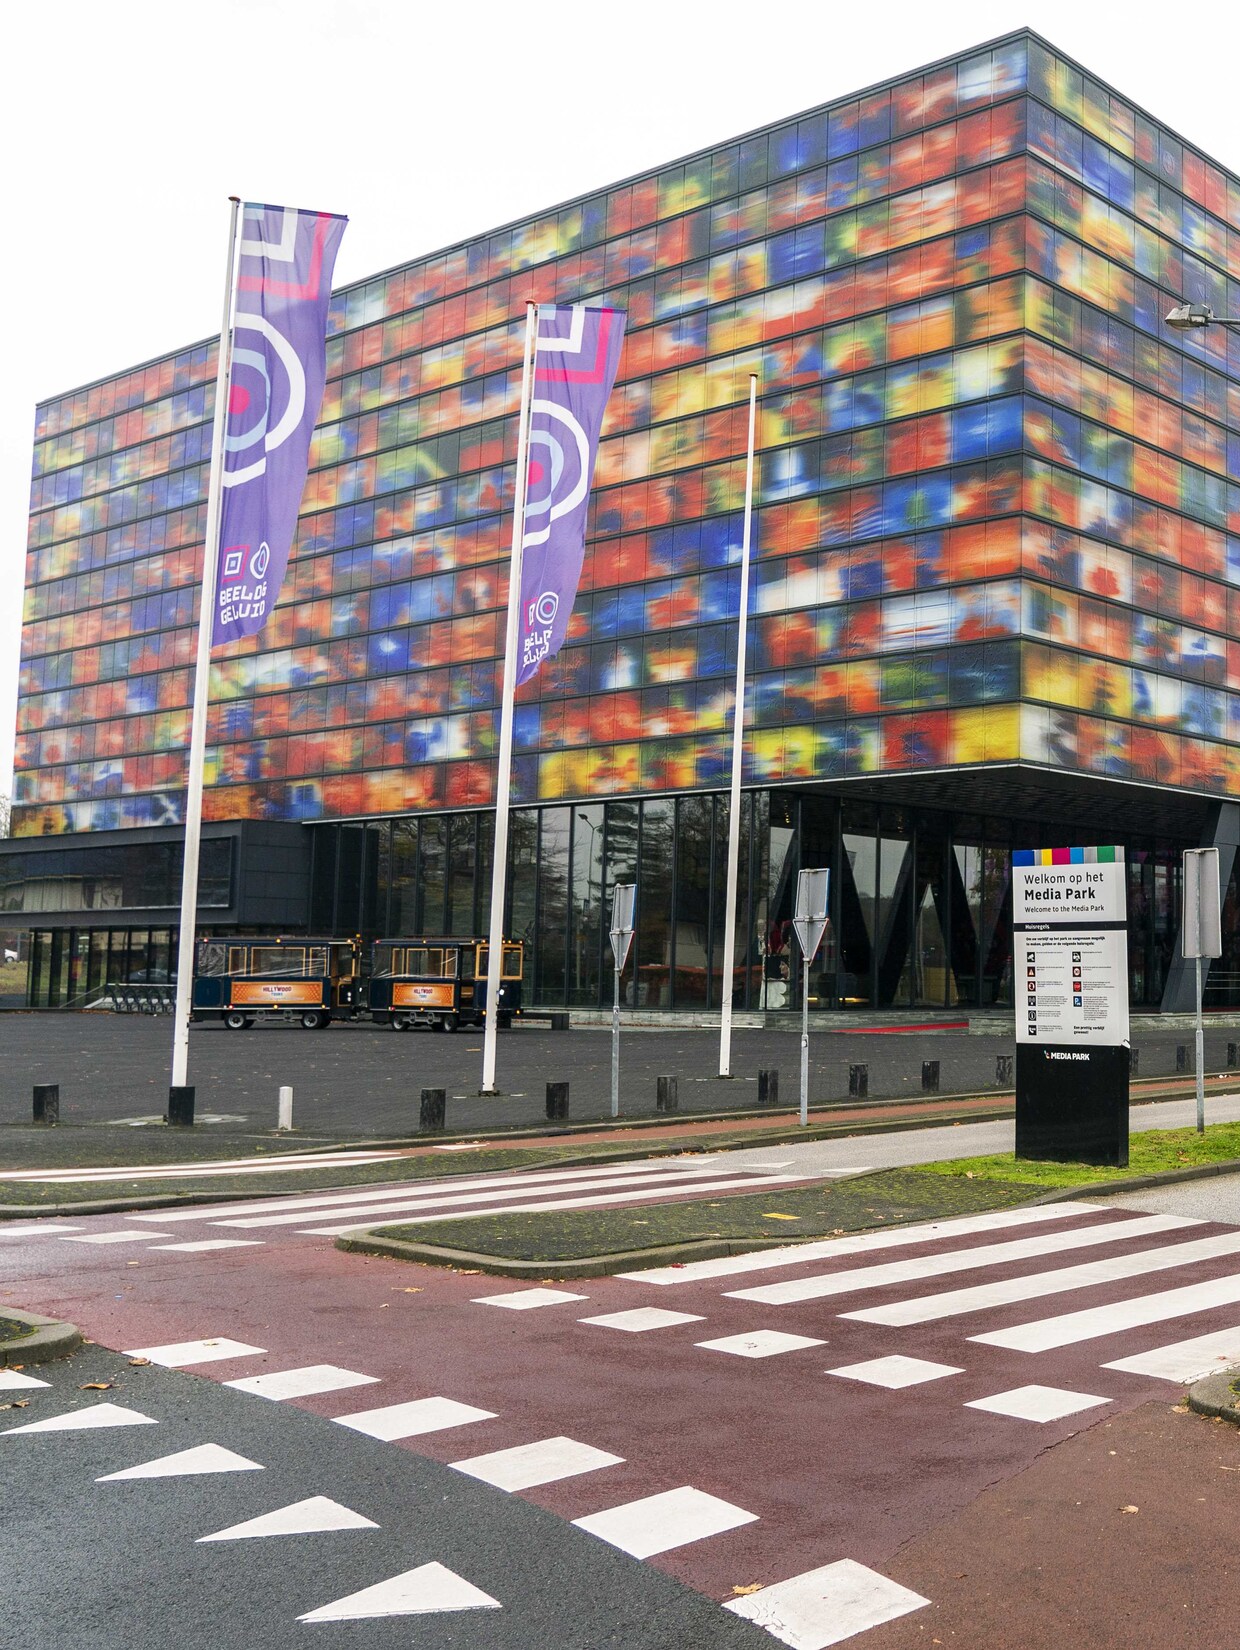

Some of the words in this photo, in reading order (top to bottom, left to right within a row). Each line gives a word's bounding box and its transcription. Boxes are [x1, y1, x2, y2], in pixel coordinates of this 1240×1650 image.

[221, 600, 265, 624] GELUID
[1024, 874, 1066, 884] Welkom
[1069, 874, 1082, 885] op
[1086, 872, 1104, 882] het
[1025, 888, 1061, 900] Media
[1066, 887, 1096, 899] Park
[1051, 1052, 1072, 1060] MEDIA
